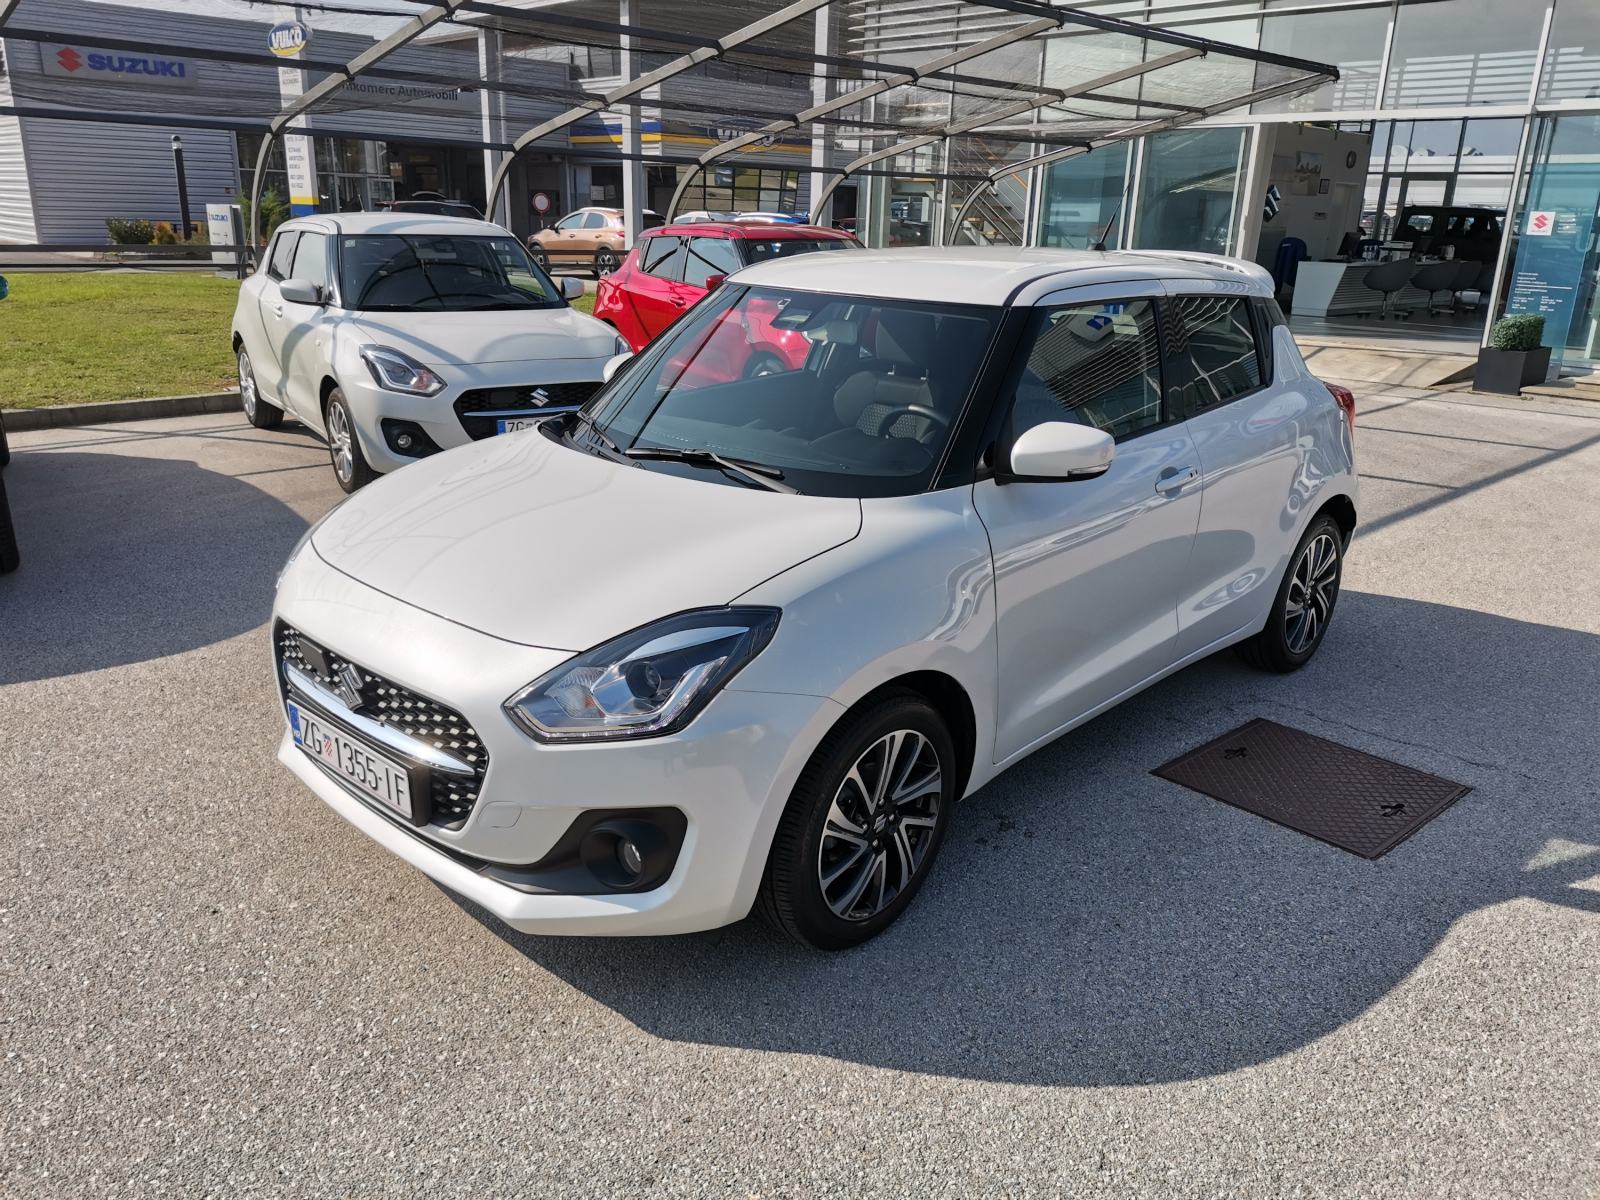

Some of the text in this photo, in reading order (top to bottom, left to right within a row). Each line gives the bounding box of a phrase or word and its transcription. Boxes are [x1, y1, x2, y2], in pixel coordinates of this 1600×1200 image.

[271, 26, 303, 49] VULCO
[87, 53, 186, 78] SUZUKI
[300, 715, 322, 755] ZG
